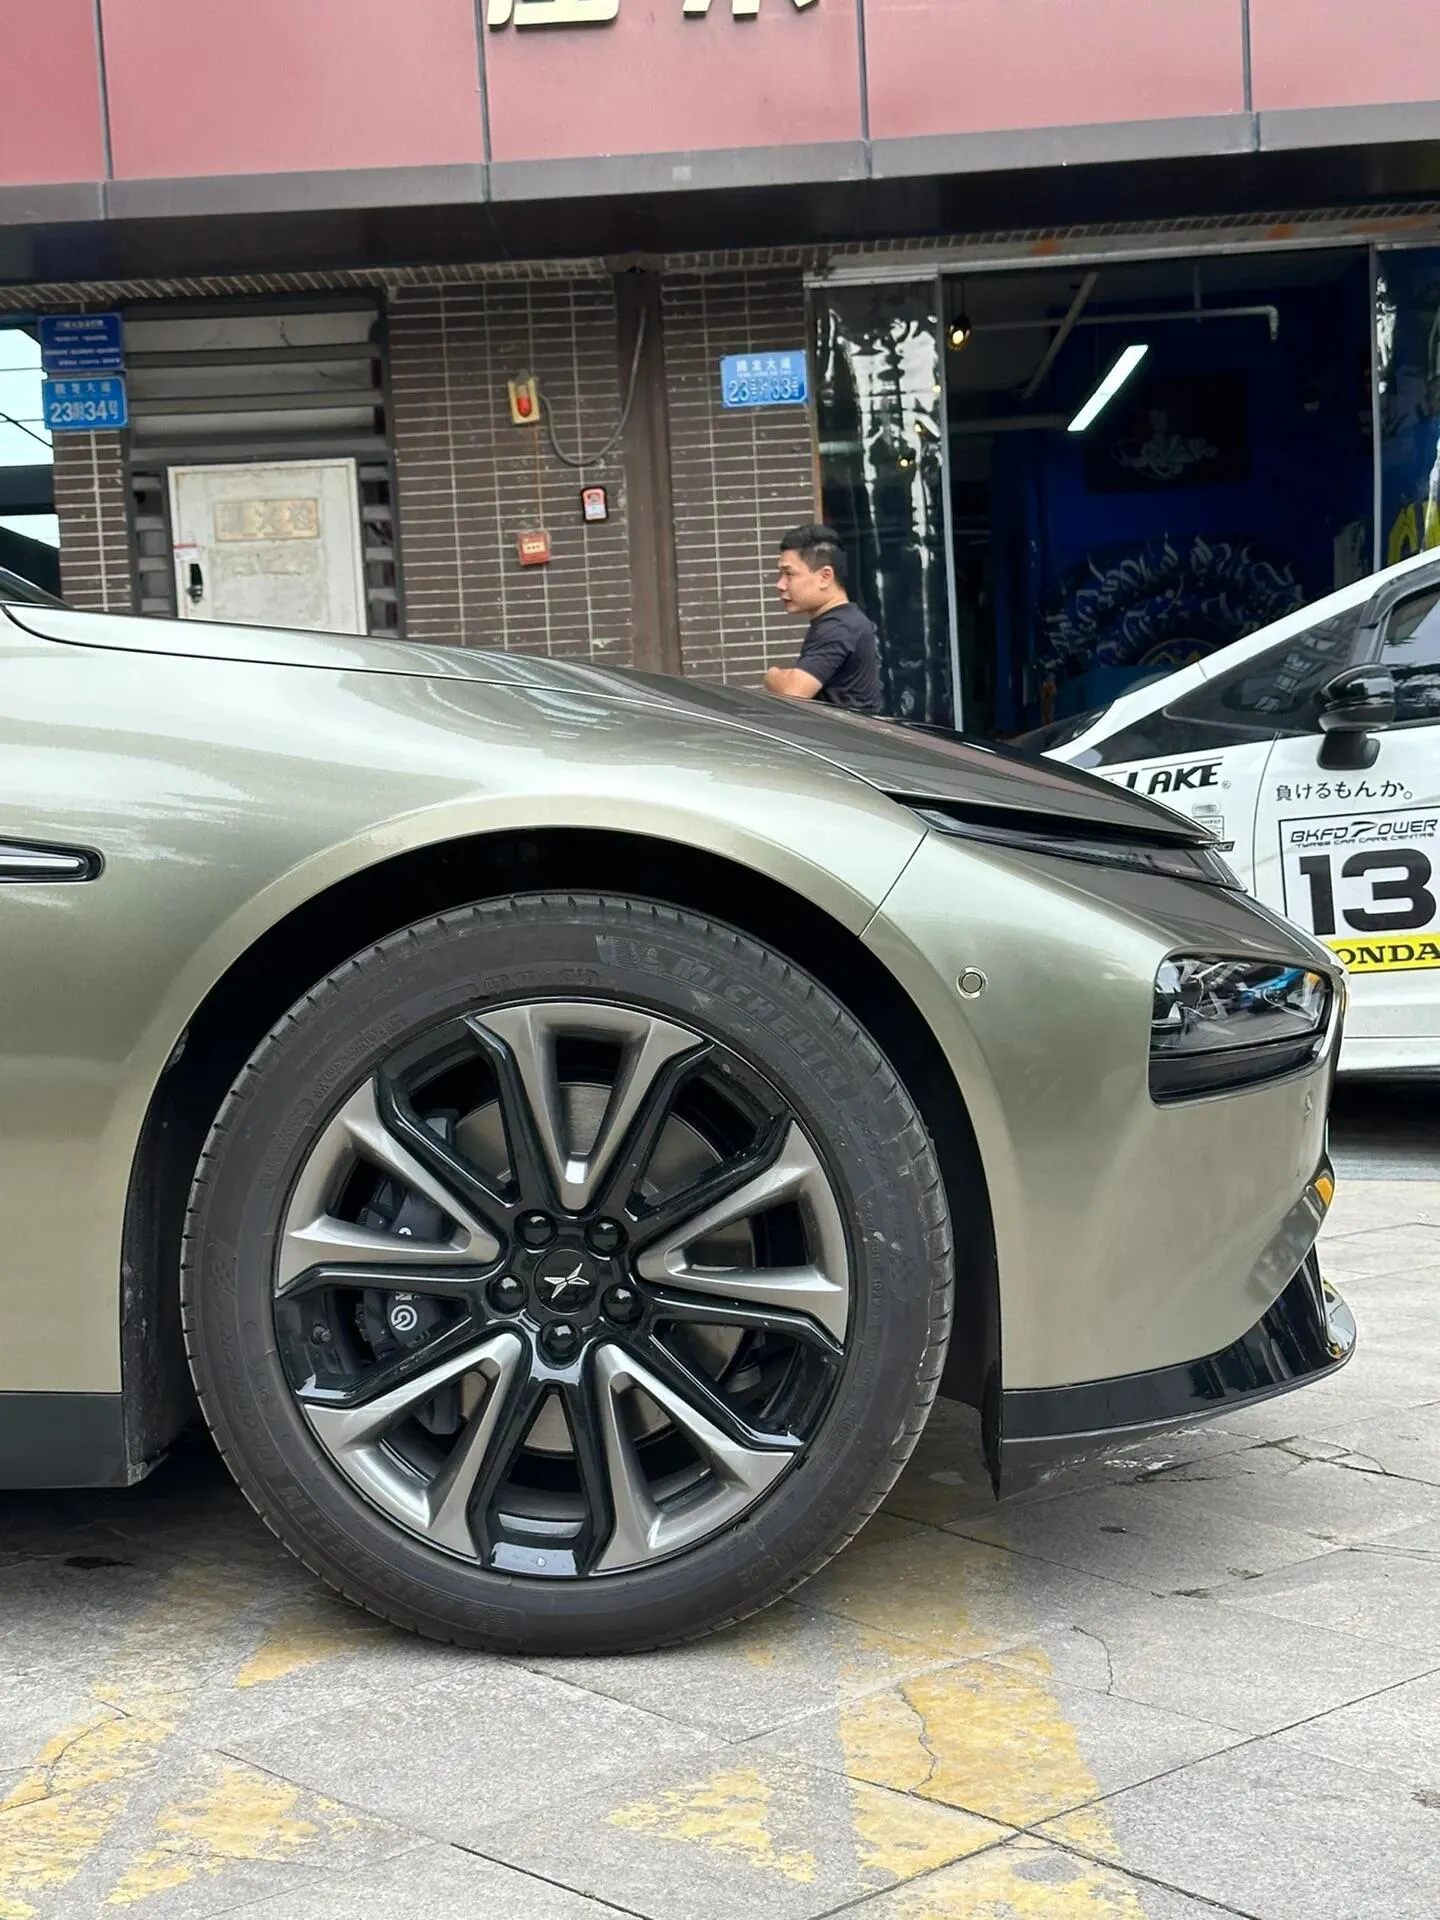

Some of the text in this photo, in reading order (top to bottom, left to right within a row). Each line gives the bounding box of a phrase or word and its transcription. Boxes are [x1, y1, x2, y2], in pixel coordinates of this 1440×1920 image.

[1276, 780, 1413, 800] 負けるもんか。
[1299, 848, 1437, 936] 13
[1335, 942, 1440, 965] ONDA
[672, 957, 851, 1091] MICHELIN
